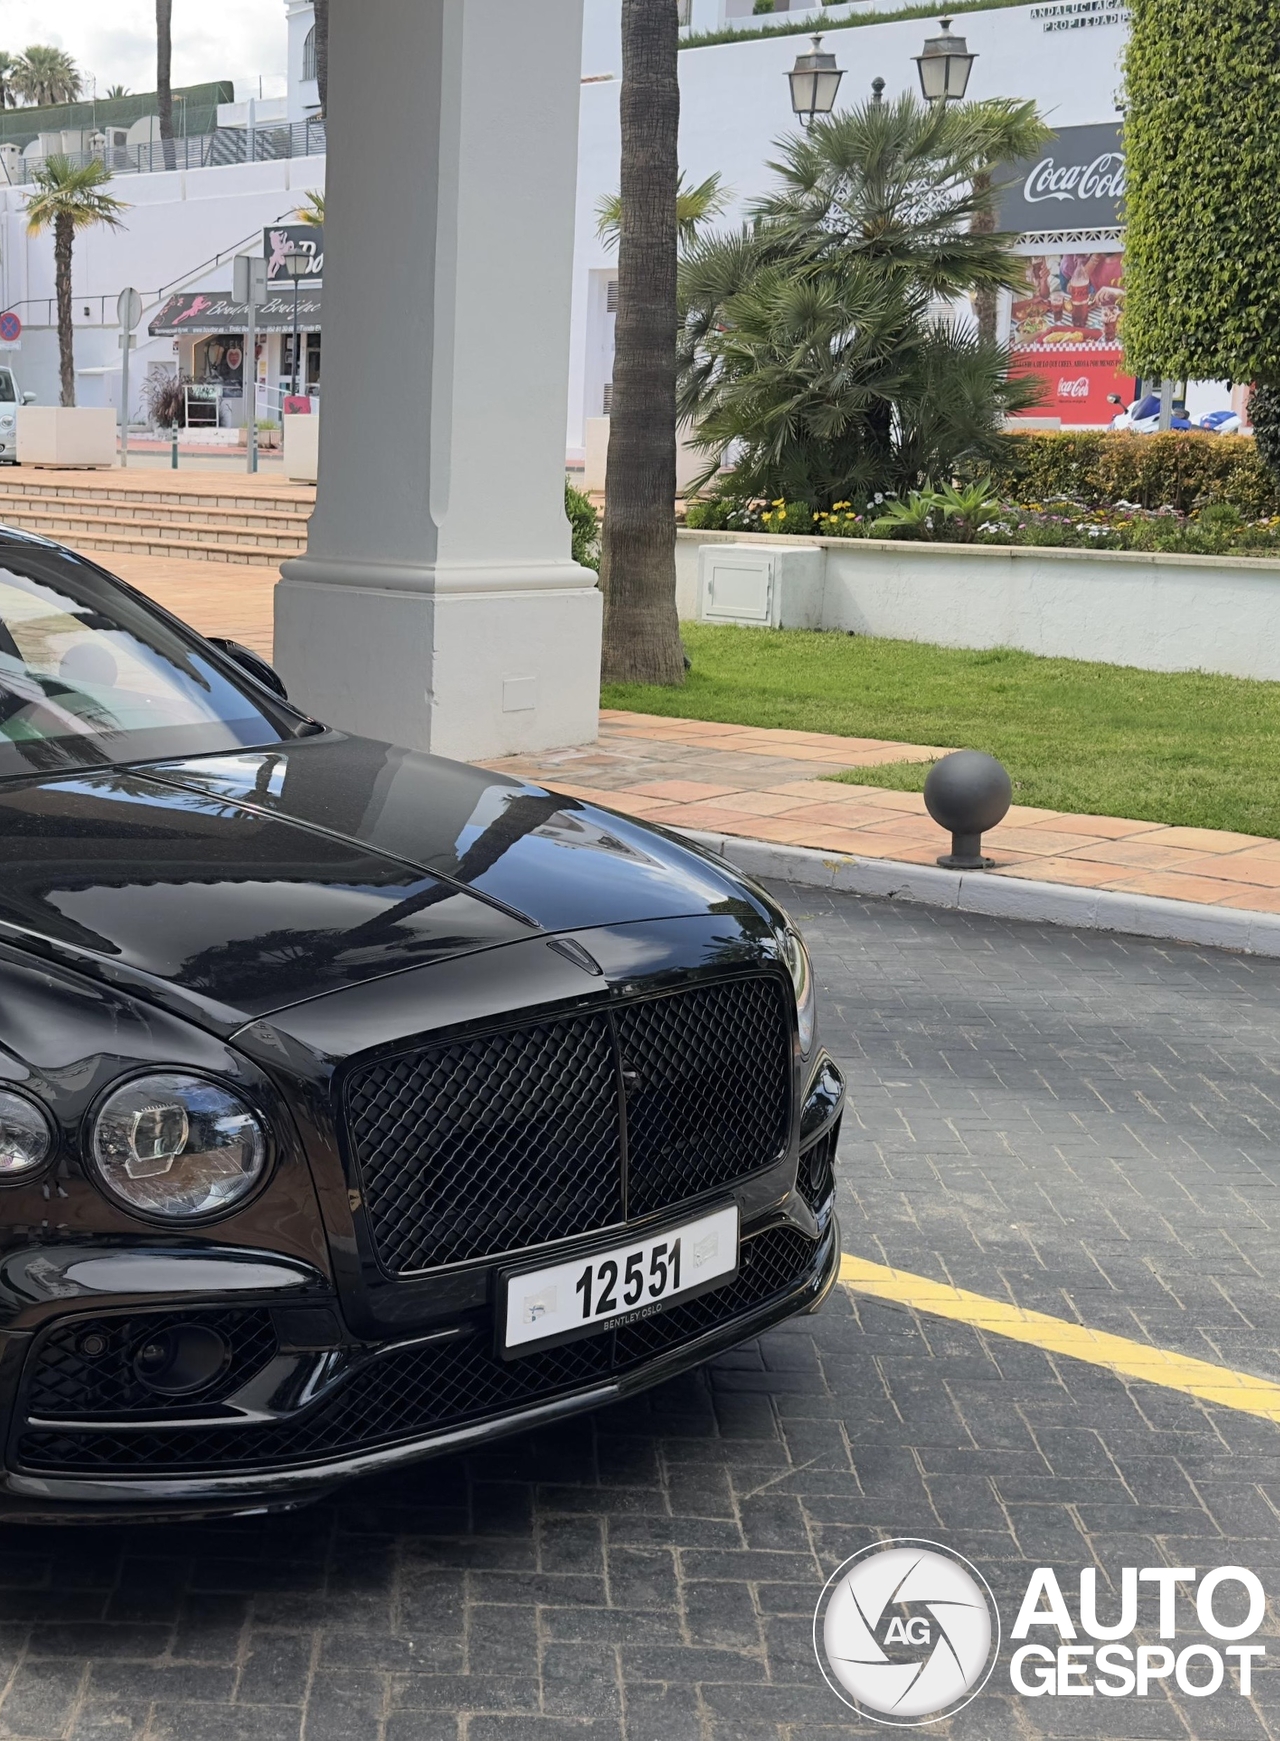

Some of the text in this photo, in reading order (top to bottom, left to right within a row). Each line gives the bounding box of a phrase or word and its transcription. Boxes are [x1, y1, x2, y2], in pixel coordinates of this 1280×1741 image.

[1030, 1, 1103, 19] ANDALUCIA
[1043, 14, 1118, 32] PROPIEDAD
[576, 1238, 681, 1319] 12551
[603, 1303, 663, 1331] BENTLEY OSLO
